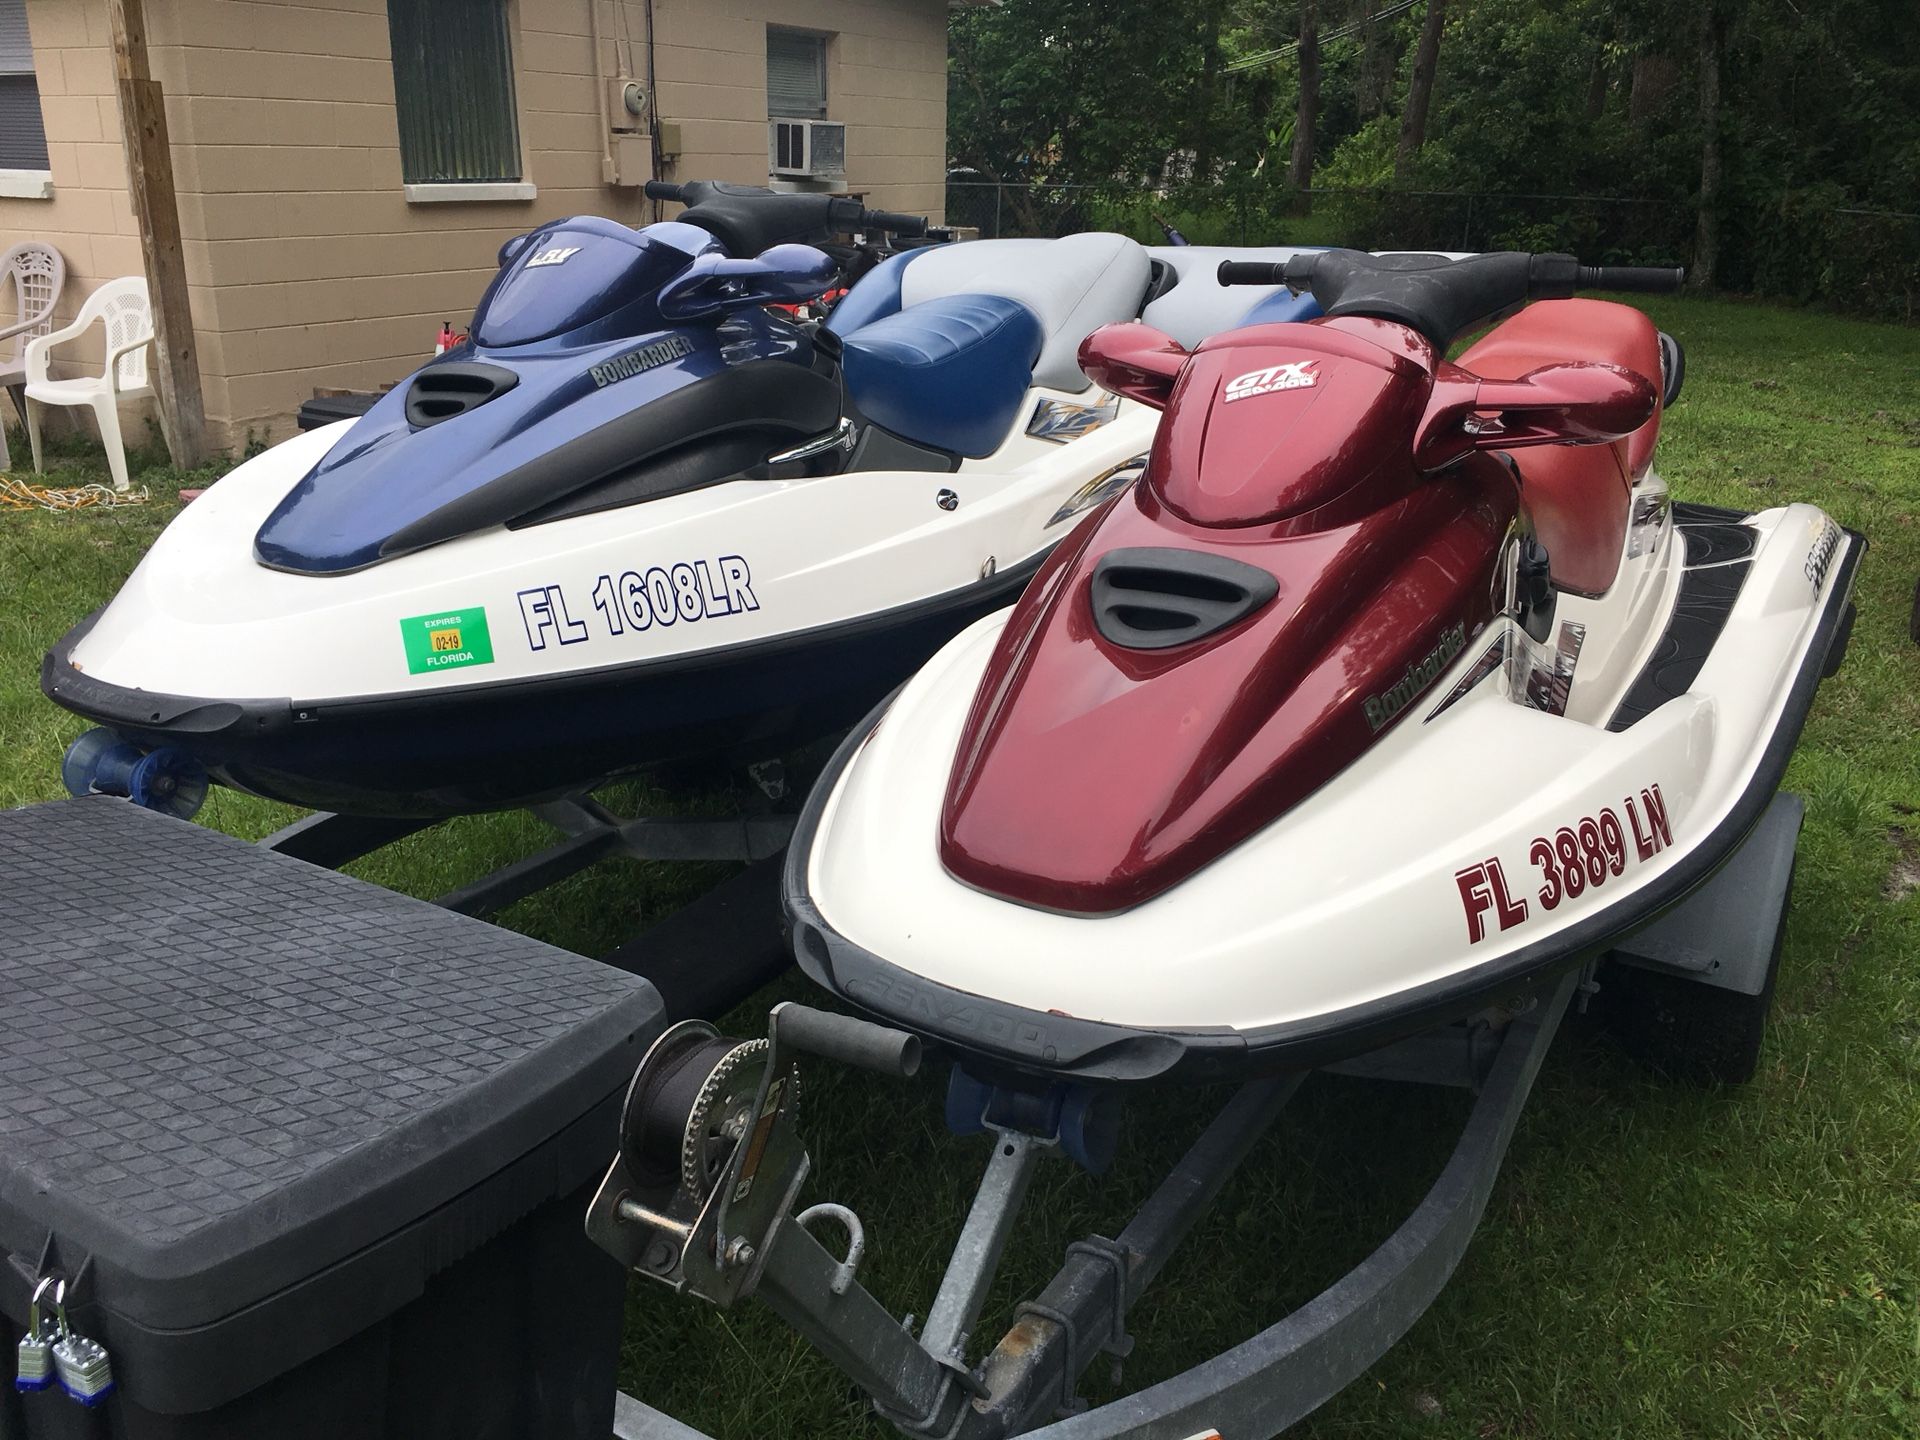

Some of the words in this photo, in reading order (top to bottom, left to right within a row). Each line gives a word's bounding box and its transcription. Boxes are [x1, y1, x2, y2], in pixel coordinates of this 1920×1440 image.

[588, 335, 696, 388] BOMBARDIER
[1225, 360, 1316, 393] GTX
[424, 616, 462, 628] EXPIRES
[517, 585, 589, 651] FL
[592, 555, 760, 636] 1608LR
[426, 652, 474, 667] FLORIDA
[435, 634, 459, 650] 02-19
[1362, 621, 1467, 733] Bombardier
[1455, 856, 1529, 945] FL
[1530, 807, 1628, 911] 3889
[1624, 783, 1674, 864] LN
